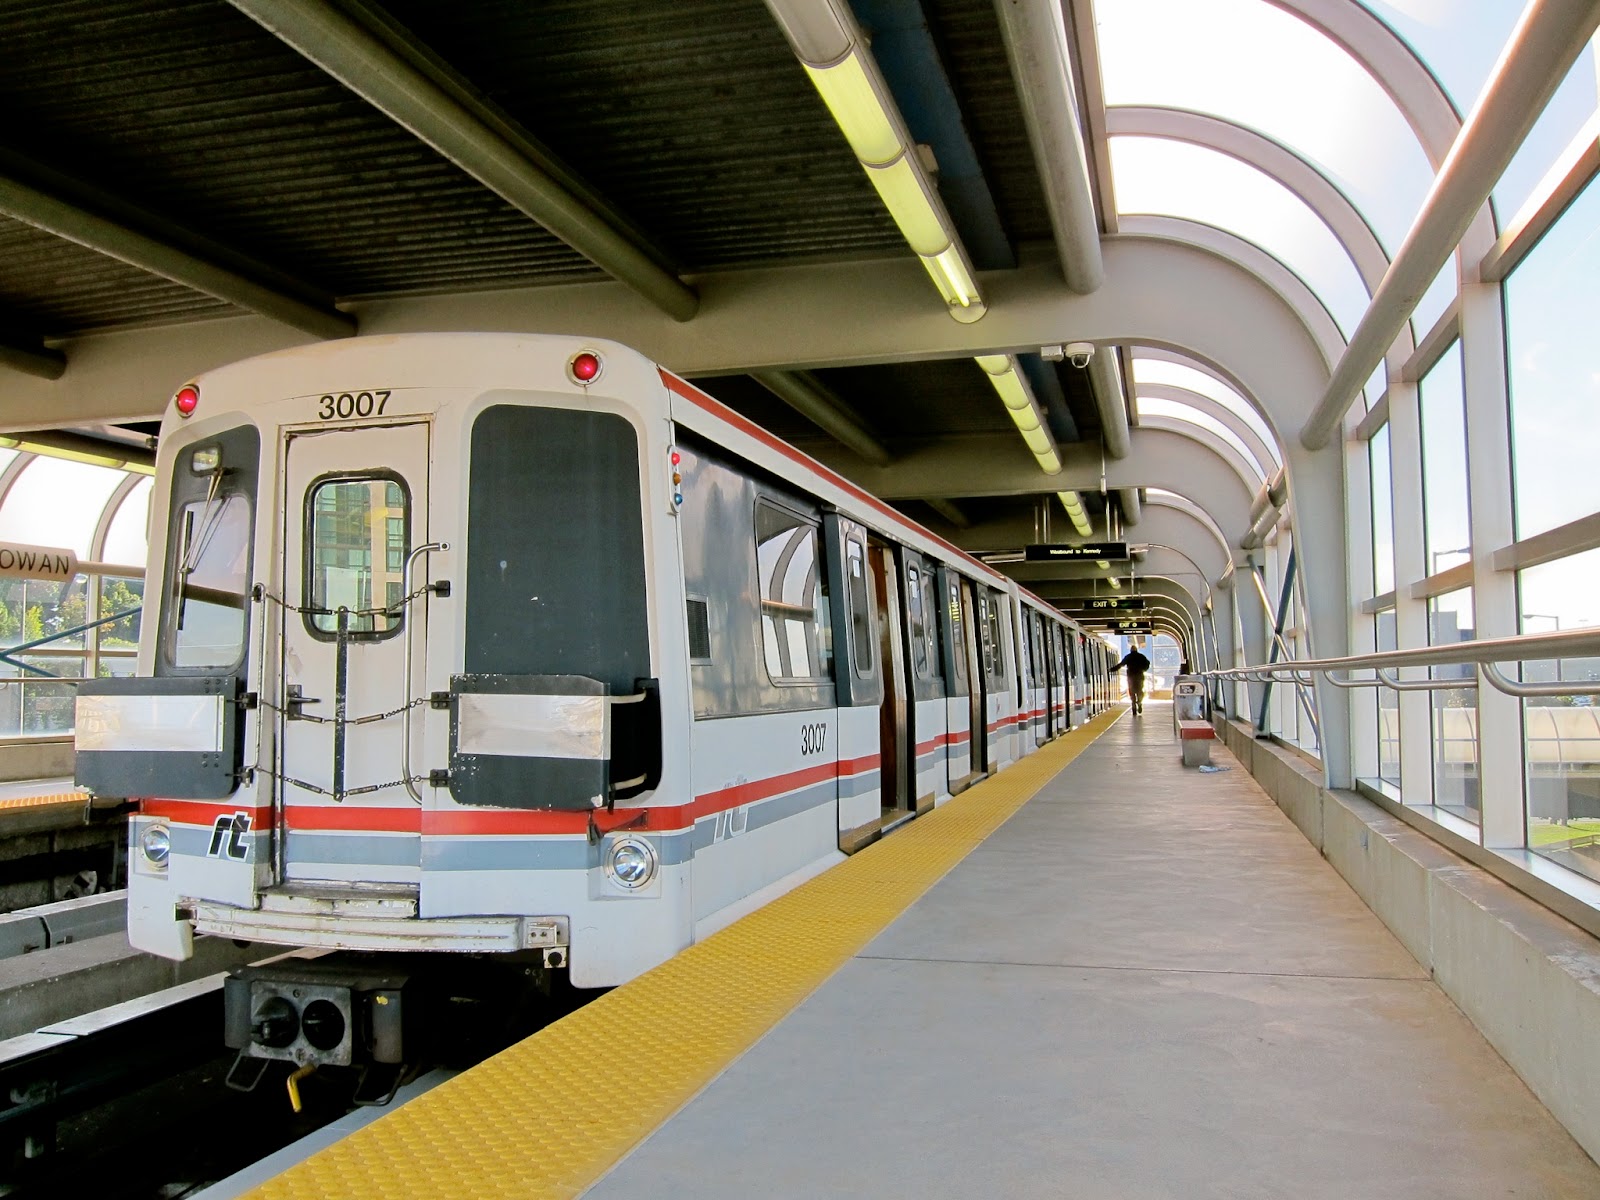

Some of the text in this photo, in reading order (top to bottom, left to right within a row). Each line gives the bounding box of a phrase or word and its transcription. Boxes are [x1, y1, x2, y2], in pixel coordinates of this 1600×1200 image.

[318, 390, 391, 420] 3007
[0, 549, 69, 575] OWAN
[1092, 600, 1108, 608] EXIT
[801, 722, 827, 756] 3007
